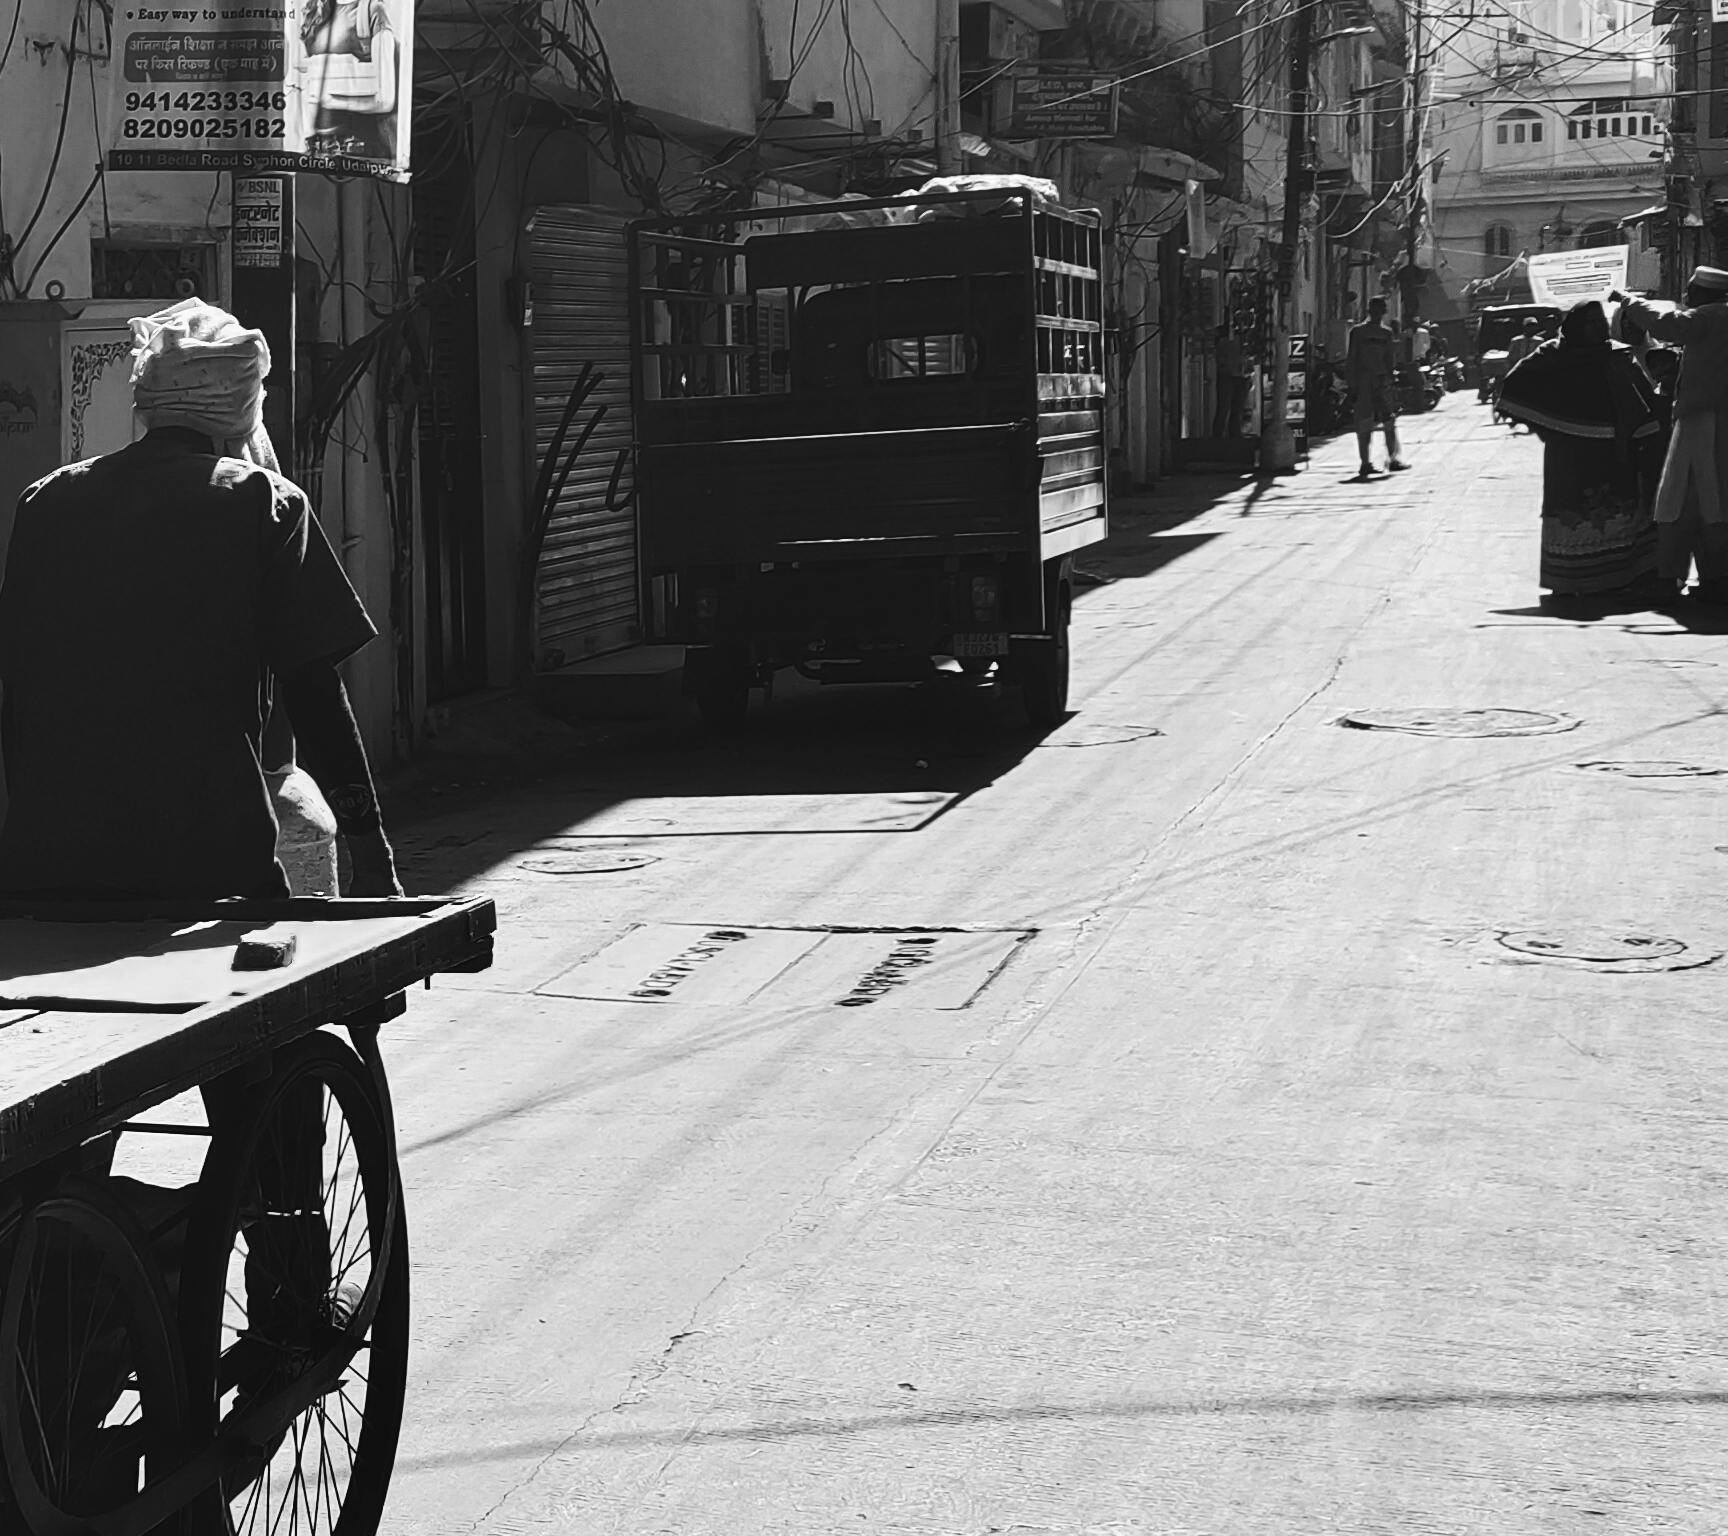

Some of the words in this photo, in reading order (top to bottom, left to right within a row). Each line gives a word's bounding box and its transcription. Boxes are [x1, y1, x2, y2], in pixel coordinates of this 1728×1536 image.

[137, 8, 169, 22] Easy
[171, 11, 198, 22] way
[202, 9, 217, 20] to
[221, 8, 296, 20] understand
[125, 91, 286, 112] 9414233346
[123, 118, 286, 139] 8209025182
[157, 154, 197, 166] Bedla
[201, 153, 238, 166] Road
[249, 180, 280, 193] BSNL
